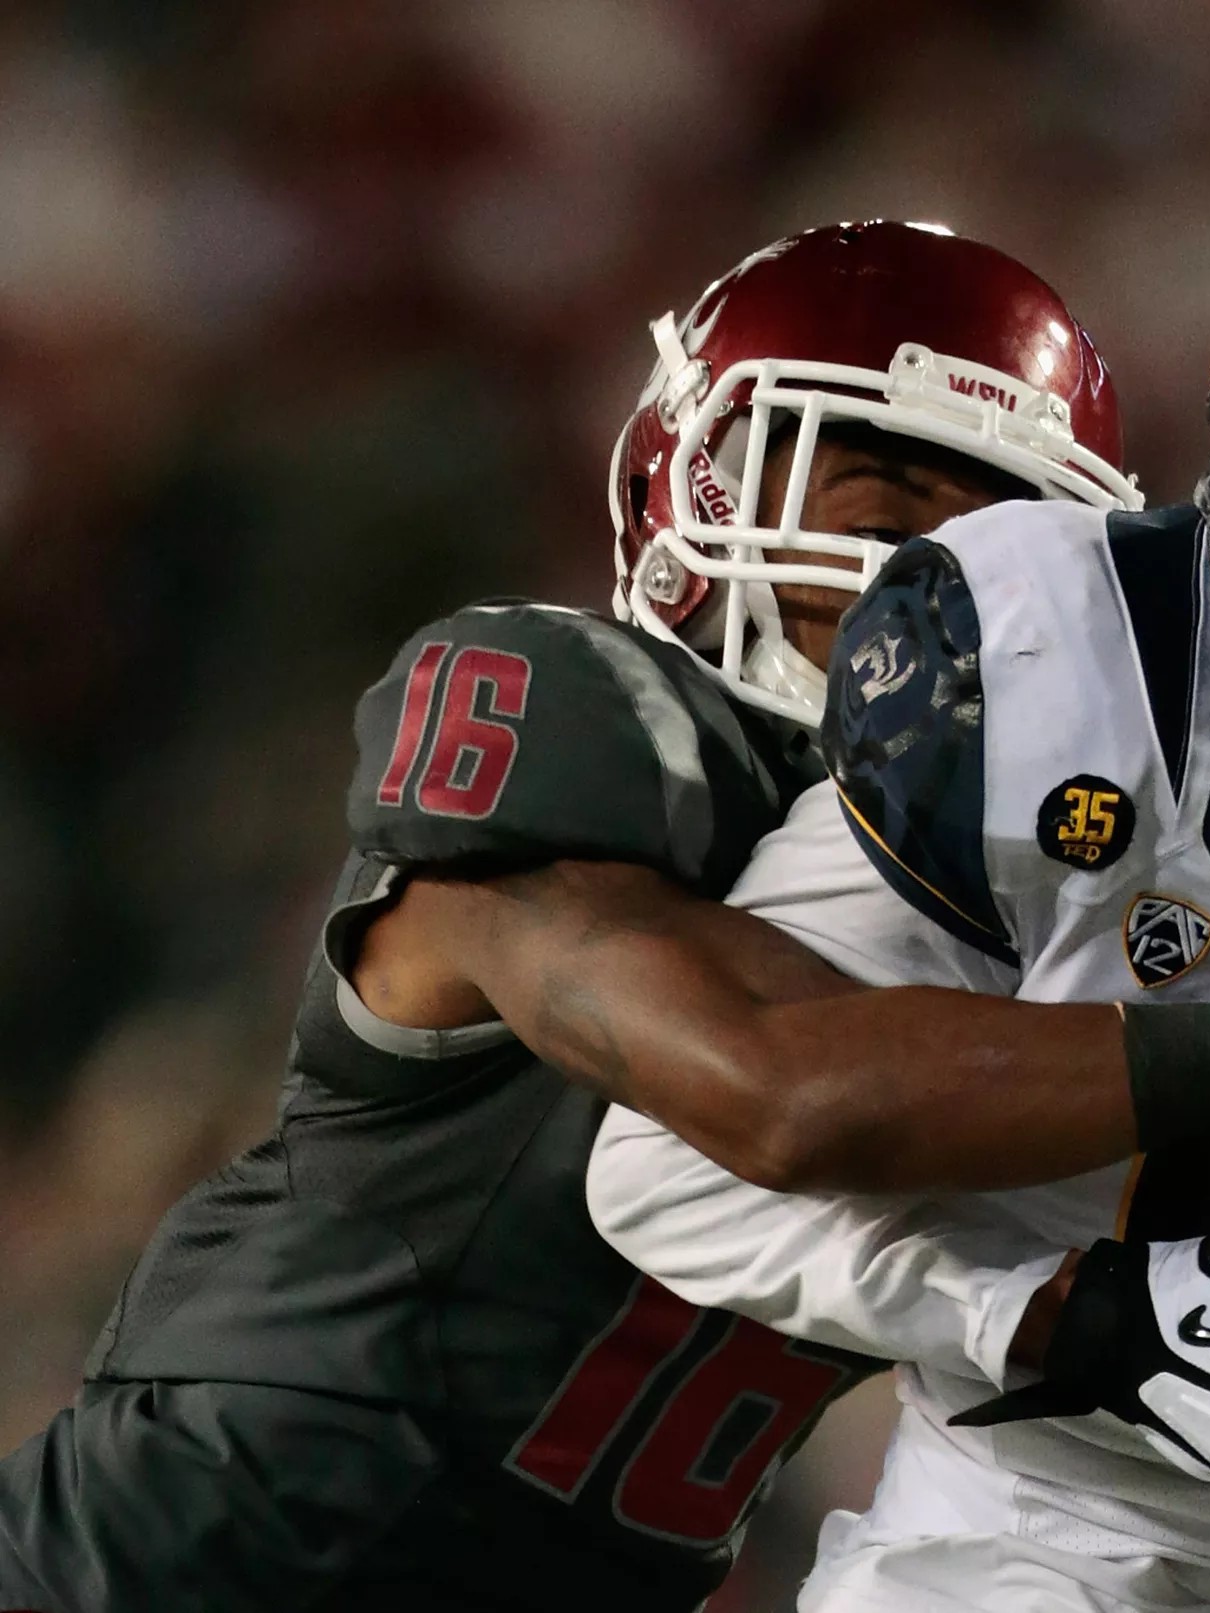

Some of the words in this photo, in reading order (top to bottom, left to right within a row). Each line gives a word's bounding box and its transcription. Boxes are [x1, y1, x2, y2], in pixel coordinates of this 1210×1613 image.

[688, 451, 736, 527] Ridd
[377, 642, 532, 821] 16
[1058, 787, 1120, 844] 35
[1132, 934, 1182, 976] 12
